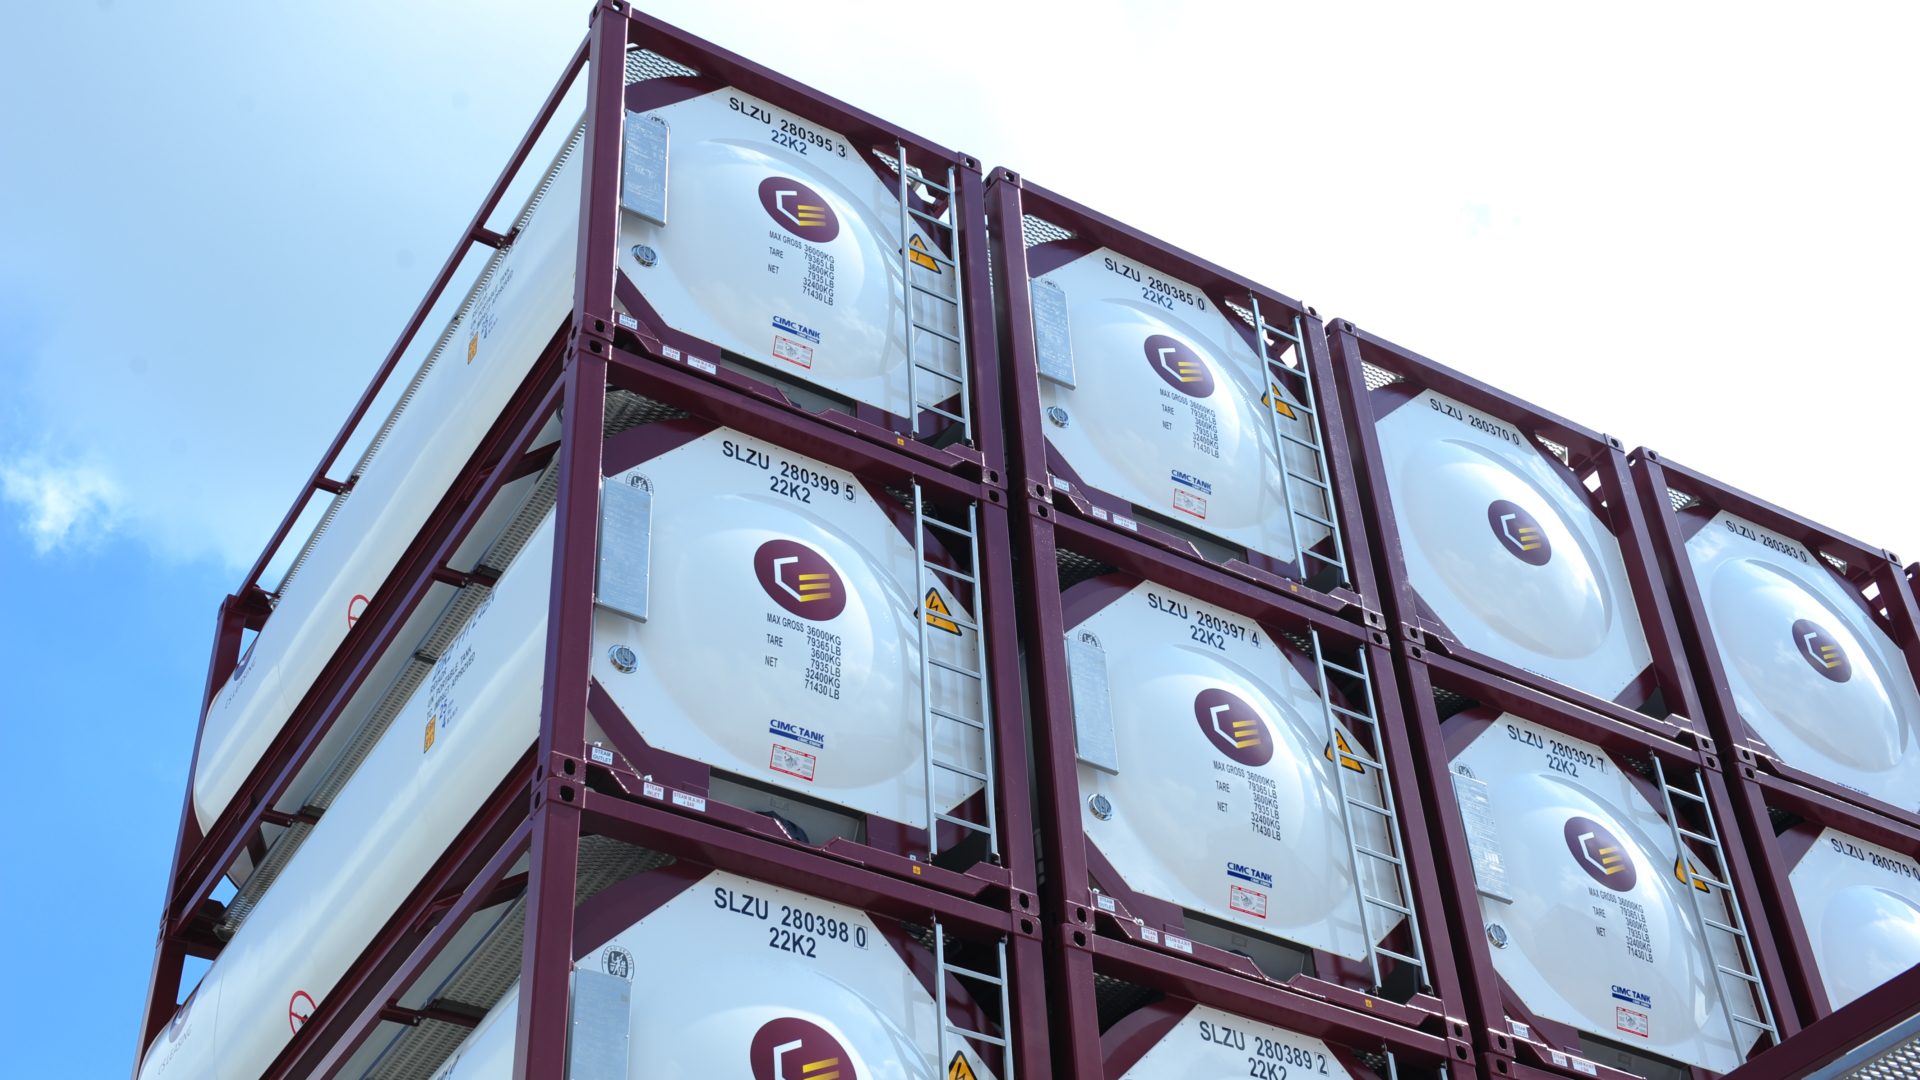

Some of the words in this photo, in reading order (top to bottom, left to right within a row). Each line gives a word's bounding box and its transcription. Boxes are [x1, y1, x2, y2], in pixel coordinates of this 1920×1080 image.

[729, 97, 771, 125] SLZU
[780, 119, 833, 152] 280395
[838, 144, 846, 158] 3
[771, 129, 807, 155] 22K2
[769, 230, 781, 241] MAX
[783, 235, 802, 249] GROSS
[769, 246, 784, 259] TARE
[768, 264, 779, 274] NET
[1104, 257, 1141, 282] SLZU
[1148, 276, 1194, 306] 280385
[1198, 298, 1205, 311] 0
[1142, 287, 1175, 310] 22K2
[773, 315, 797, 330] CIMC
[798, 324, 821, 339] TANK
[1430, 398, 1463, 421] SLZU
[1468, 414, 1510, 441] 280370
[1512, 433, 1520, 446] 0
[722, 440, 770, 470] SLZU
[780, 461, 839, 495] 280399
[845, 484, 854, 501] 5
[1171, 469, 1192, 483] CIMC
[1192, 477, 1212, 490] TANK
[770, 476, 811, 504] 22K2
[1726, 520, 1756, 541] SLZU
[1760, 534, 1798, 559] 280383
[767, 612, 781, 625] MAX
[782, 617, 805, 633] GROSS
[1147, 592, 1188, 620] SLZU
[1196, 610, 1246, 641] 280397
[1251, 631, 1259, 648] 4
[766, 633, 783, 648] TARE
[1190, 624, 1226, 651] 22K2
[765, 655, 778, 668] NET
[805, 678, 828, 696] 71430
[770, 719, 798, 734] CIMC
[798, 727, 825, 742] TANK
[1507, 724, 1544, 749] SLZU
[1549, 740, 1596, 769] 280392
[1597, 757, 1605, 773] 7
[1546, 754, 1579, 778] 22K2
[1830, 838, 1865, 861] SLZU
[1868, 852, 1911, 878] 280379
[1227, 862, 1250, 875] CIMC
[1251, 868, 1272, 882] TANK
[714, 887, 769, 920] SLZU
[781, 905, 849, 943] 280398
[856, 926, 866, 948] 0
[769, 927, 817, 959] 22K2
[1611, 985, 1632, 997] CIMC
[1631, 991, 1651, 1003] TANK
[1199, 1020, 1246, 1051] SLZU
[1254, 1036, 1313, 1070] 280389
[1317, 1054, 1328, 1075] 2
[1248, 1057, 1287, 1080] 22K2
